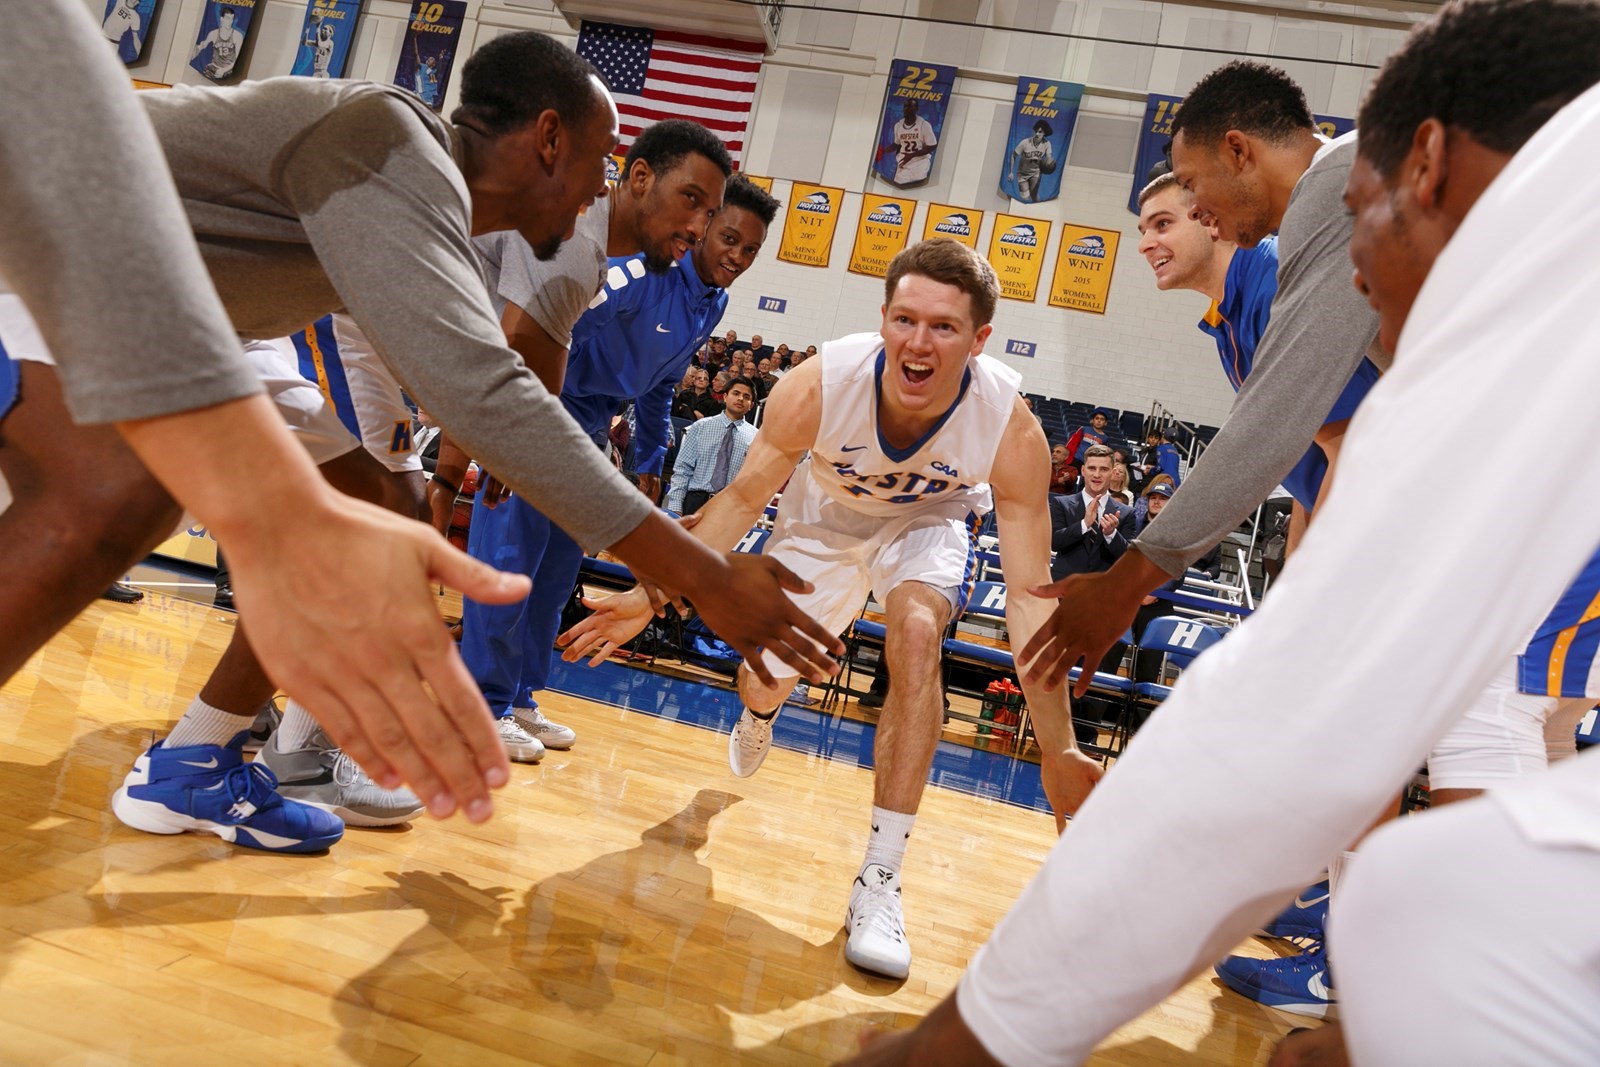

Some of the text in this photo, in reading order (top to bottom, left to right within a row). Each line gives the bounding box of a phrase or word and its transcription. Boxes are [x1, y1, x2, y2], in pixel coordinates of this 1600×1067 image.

[415, 2, 444, 23] 10
[411, 21, 454, 35] CLAXTON
[899, 66, 938, 91] 22
[893, 87, 943, 102] JENKINS
[1022, 83, 1058, 108] 14
[1020, 105, 1059, 119] IRWIN
[798, 201, 830, 212] HOFSTRA
[799, 215, 825, 228] NIT
[870, 213, 903, 224] HOFSTRA
[865, 225, 903, 240] WNIT
[937, 223, 970, 234] HOFSTRA
[800, 232, 817, 241] 2007
[1003, 233, 1036, 245] HOFSTRA
[871, 243, 888, 252] 2007
[1000, 247, 1034, 261] WNIT
[1070, 244, 1105, 257] HOFSTRA
[783, 251, 825, 264] BASKETBALL
[1004, 265, 1021, 274] 2012
[1068, 257, 1103, 272] WNIT
[999, 278, 1027, 289] OMEN'S
[1073, 276, 1091, 285] 2015
[1001, 287, 1031, 298] ETBALL
[1062, 288, 1097, 300] WOMEN'S
[1053, 296, 1101, 309] BASKETBALL
[1011, 341, 1030, 354] 112
[390, 420, 411, 454] H
[931, 461, 958, 478] CAA
[1168, 622, 1204, 648] H
